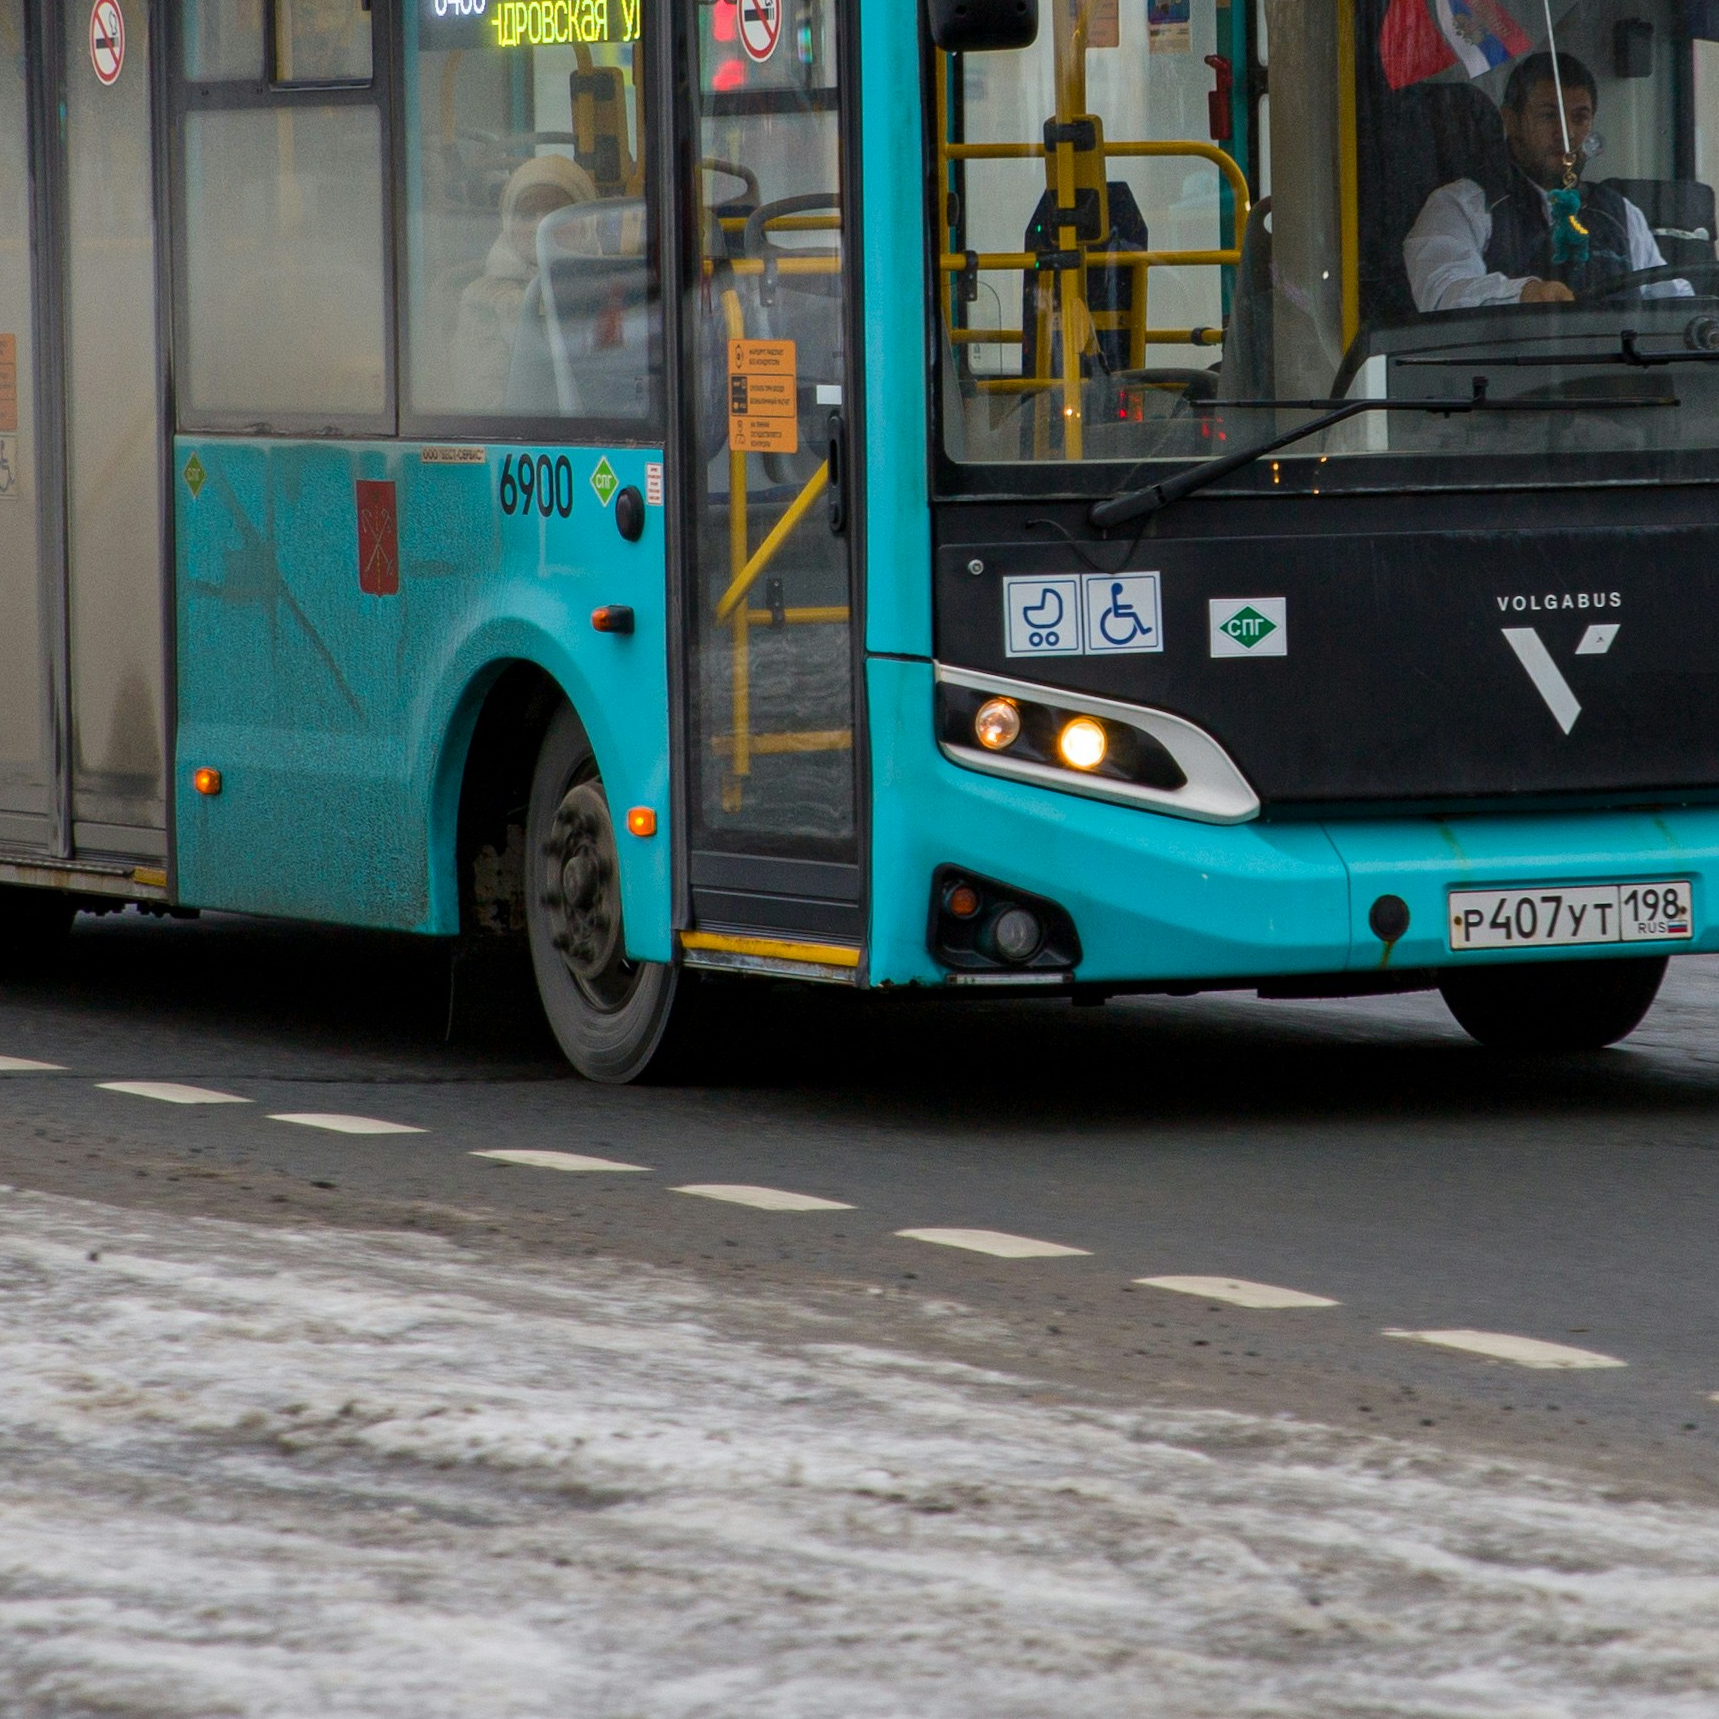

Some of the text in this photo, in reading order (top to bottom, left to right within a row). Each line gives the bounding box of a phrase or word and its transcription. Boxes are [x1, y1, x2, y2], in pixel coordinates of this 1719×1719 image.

[500, 453, 573, 518] 6900
[595, 473, 613, 490] СПГ
[1496, 591, 1621, 612] VOLGABUS
[1227, 618, 1265, 637] СПГ
[1624, 888, 1679, 922] 198
[1637, 921, 1667, 934] RUS
